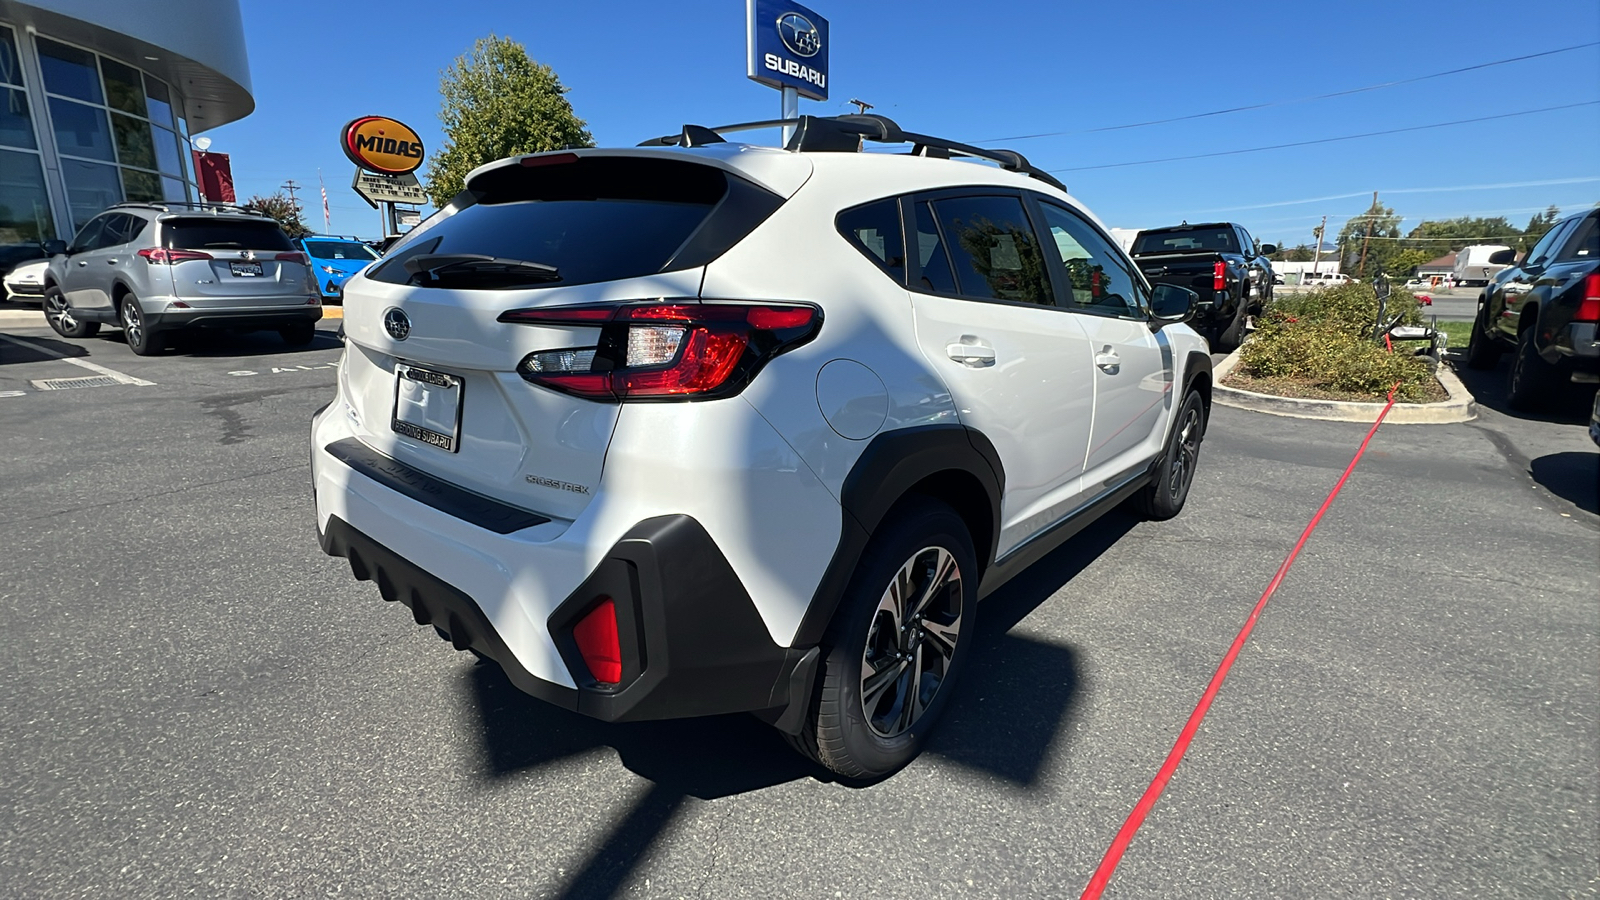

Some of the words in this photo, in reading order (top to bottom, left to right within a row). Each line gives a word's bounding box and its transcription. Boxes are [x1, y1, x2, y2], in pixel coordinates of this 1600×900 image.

[765, 53, 825, 88] SUBARU
[395, 421, 421, 439] REDDING
[421, 430, 450, 449] SUBARU
[525, 474, 590, 495] CROSSTREK
